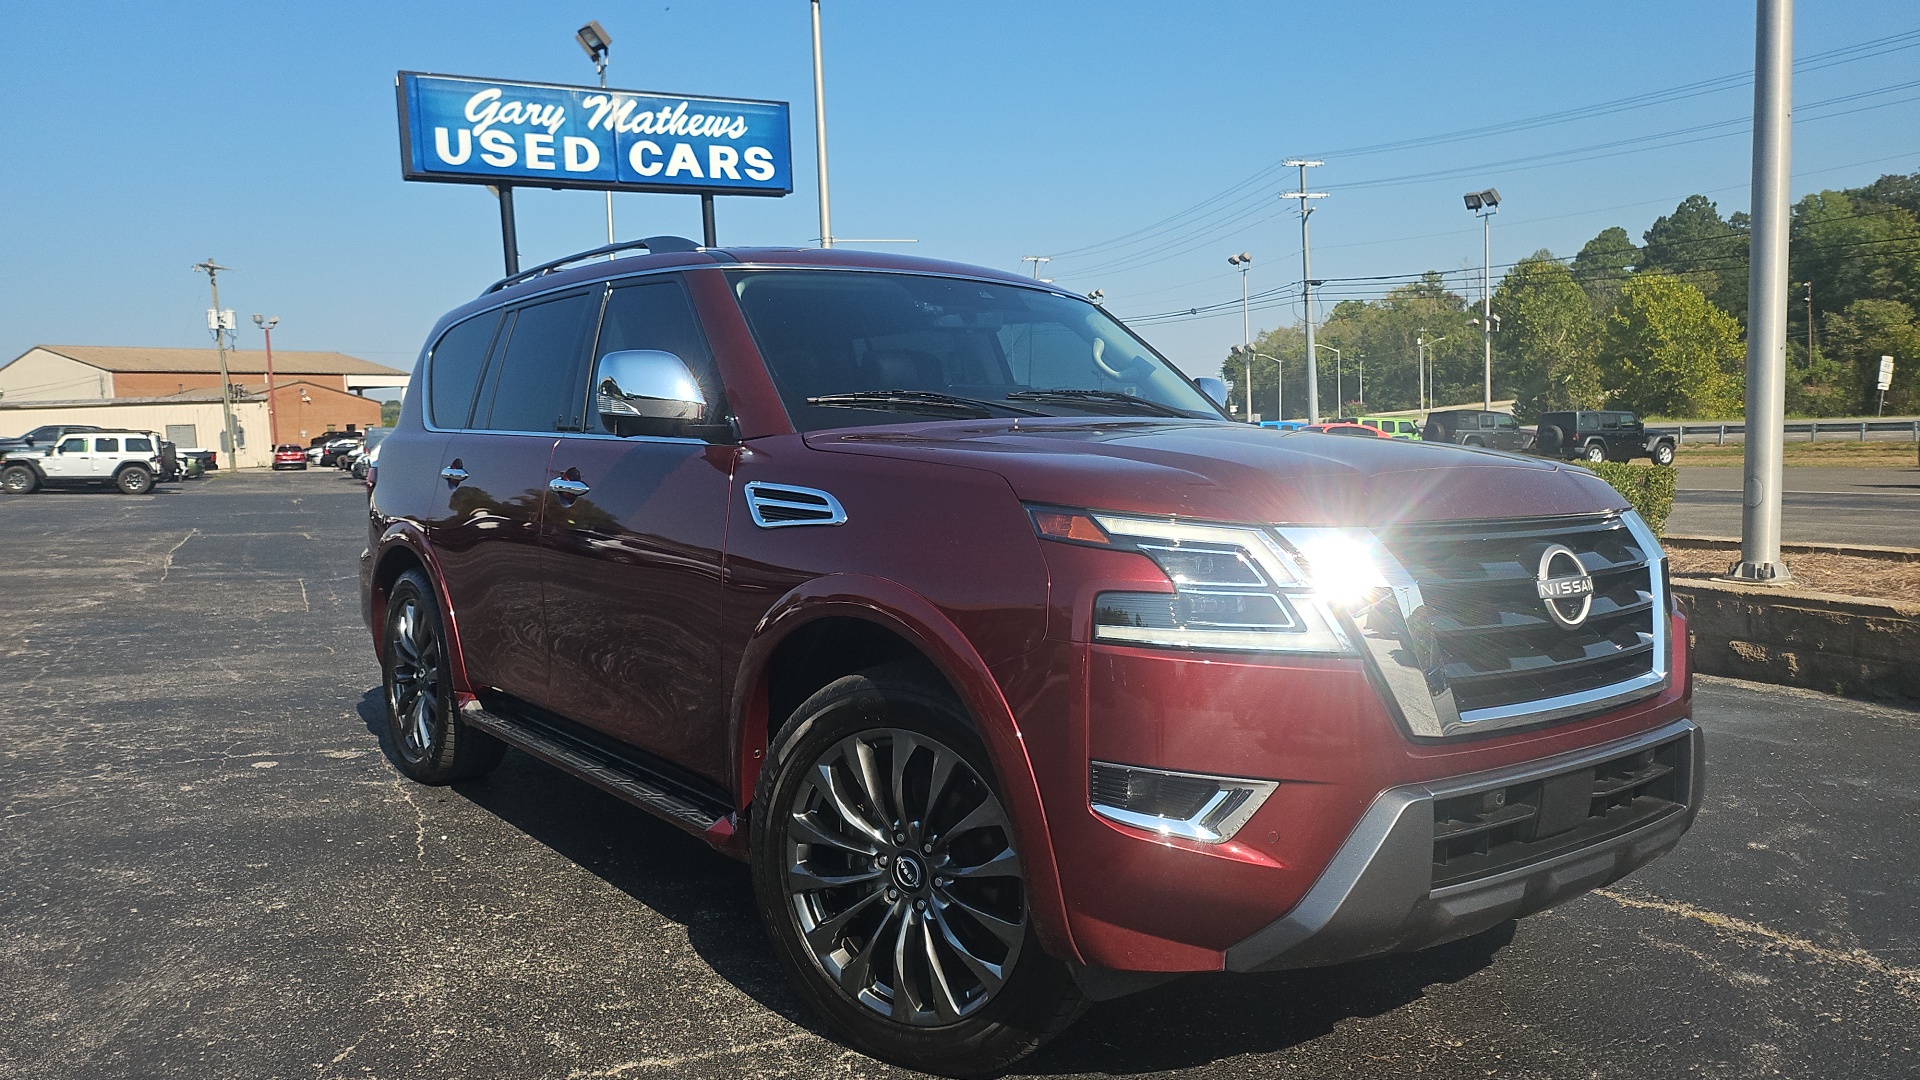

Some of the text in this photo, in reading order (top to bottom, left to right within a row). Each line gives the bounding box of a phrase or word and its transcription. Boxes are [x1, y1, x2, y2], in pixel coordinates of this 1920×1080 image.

[464, 88, 749, 138] Gary Mathews
[434, 127, 776, 182] USED CARS
[1540, 579, 1593, 596] NISSAN
